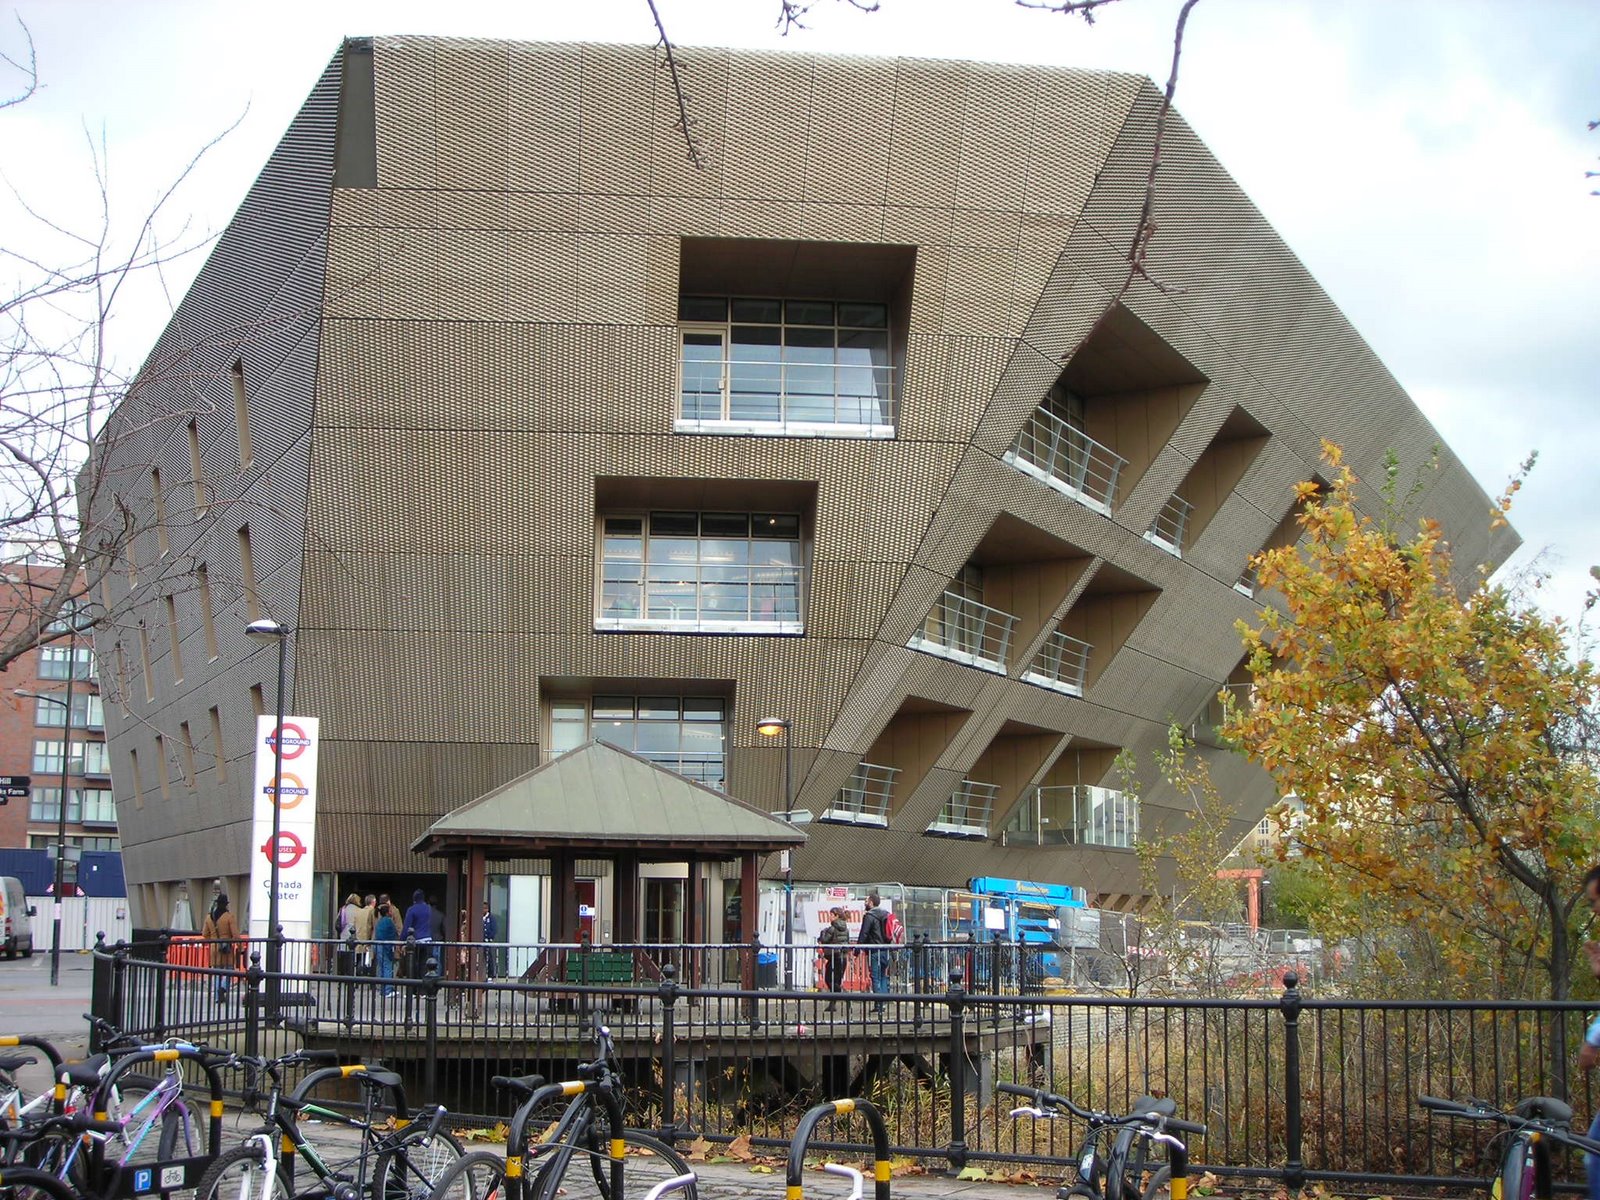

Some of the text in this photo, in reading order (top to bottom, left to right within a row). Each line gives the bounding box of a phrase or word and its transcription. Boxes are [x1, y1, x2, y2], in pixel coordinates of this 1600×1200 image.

[266, 787, 306, 795] OVGROUND
[263, 879, 302, 889] Cnada
[138, 1172, 149, 1189] P
